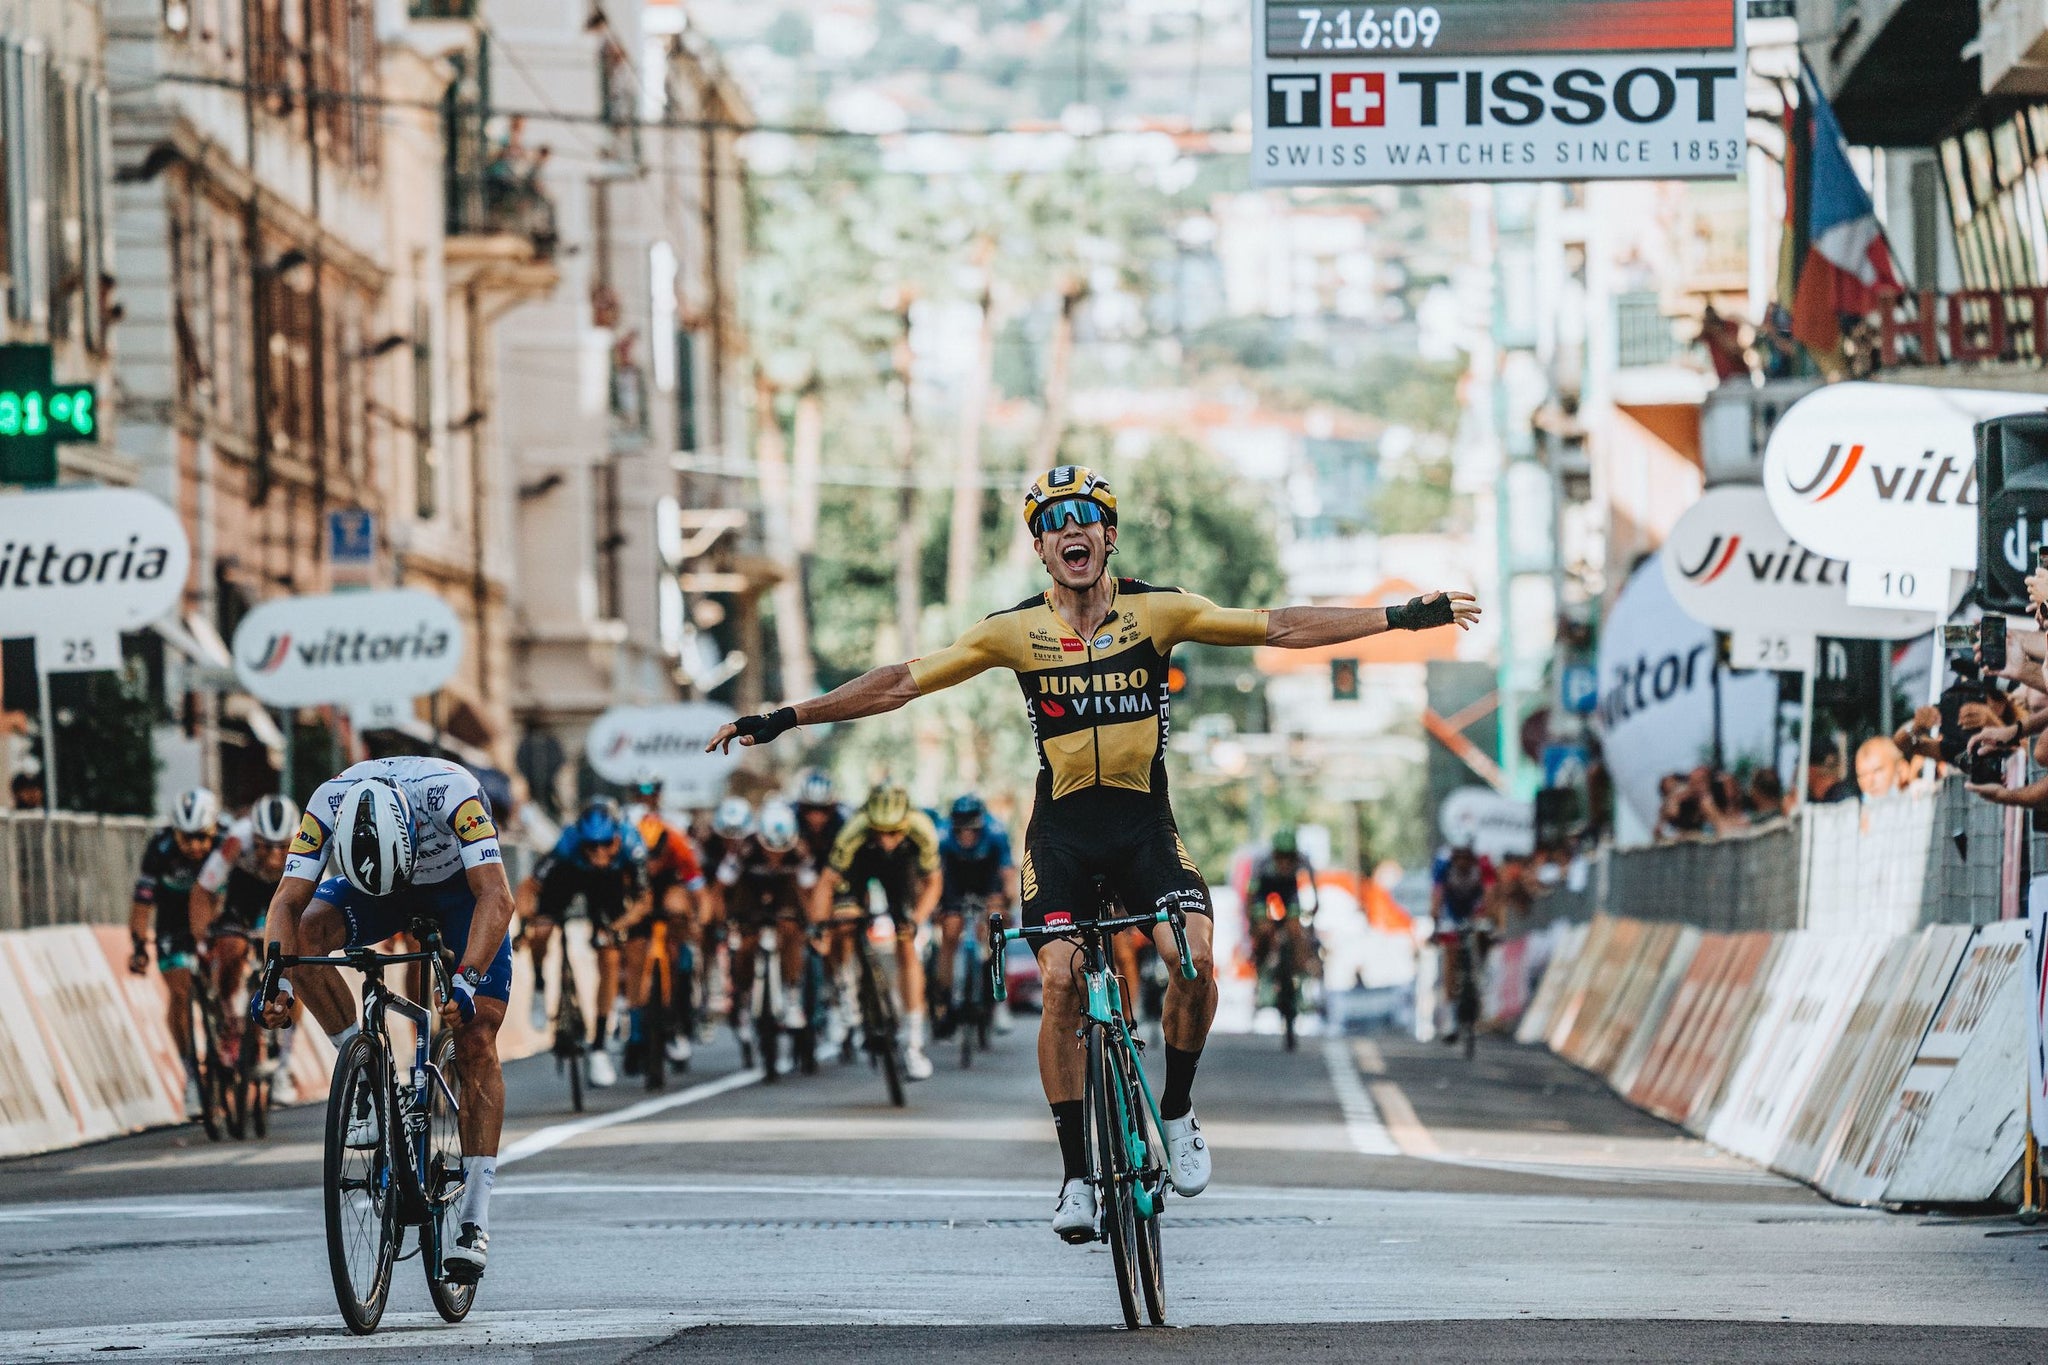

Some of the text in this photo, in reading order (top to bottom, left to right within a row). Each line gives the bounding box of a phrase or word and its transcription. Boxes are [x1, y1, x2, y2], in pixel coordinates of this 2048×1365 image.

[1298, 8, 1441, 50] 7:16:09
[1398, 67, 1737, 127] TISSOT
[1267, 139, 1739, 167] SWISS WATCHES SINCE 1853
[1883, 571, 1916, 598] 10
[64, 639, 95, 662] 25
[298, 620, 449, 667] vittoria
[1759, 639, 1789, 661] 25
[1038, 668, 1149, 696] JUMBO
[1071, 692, 1153, 716] VISMA
[1159, 682, 1171, 761] HEMA
[427, 795, 445, 812] PRO
[1047, 917, 1069, 927] HEMA
